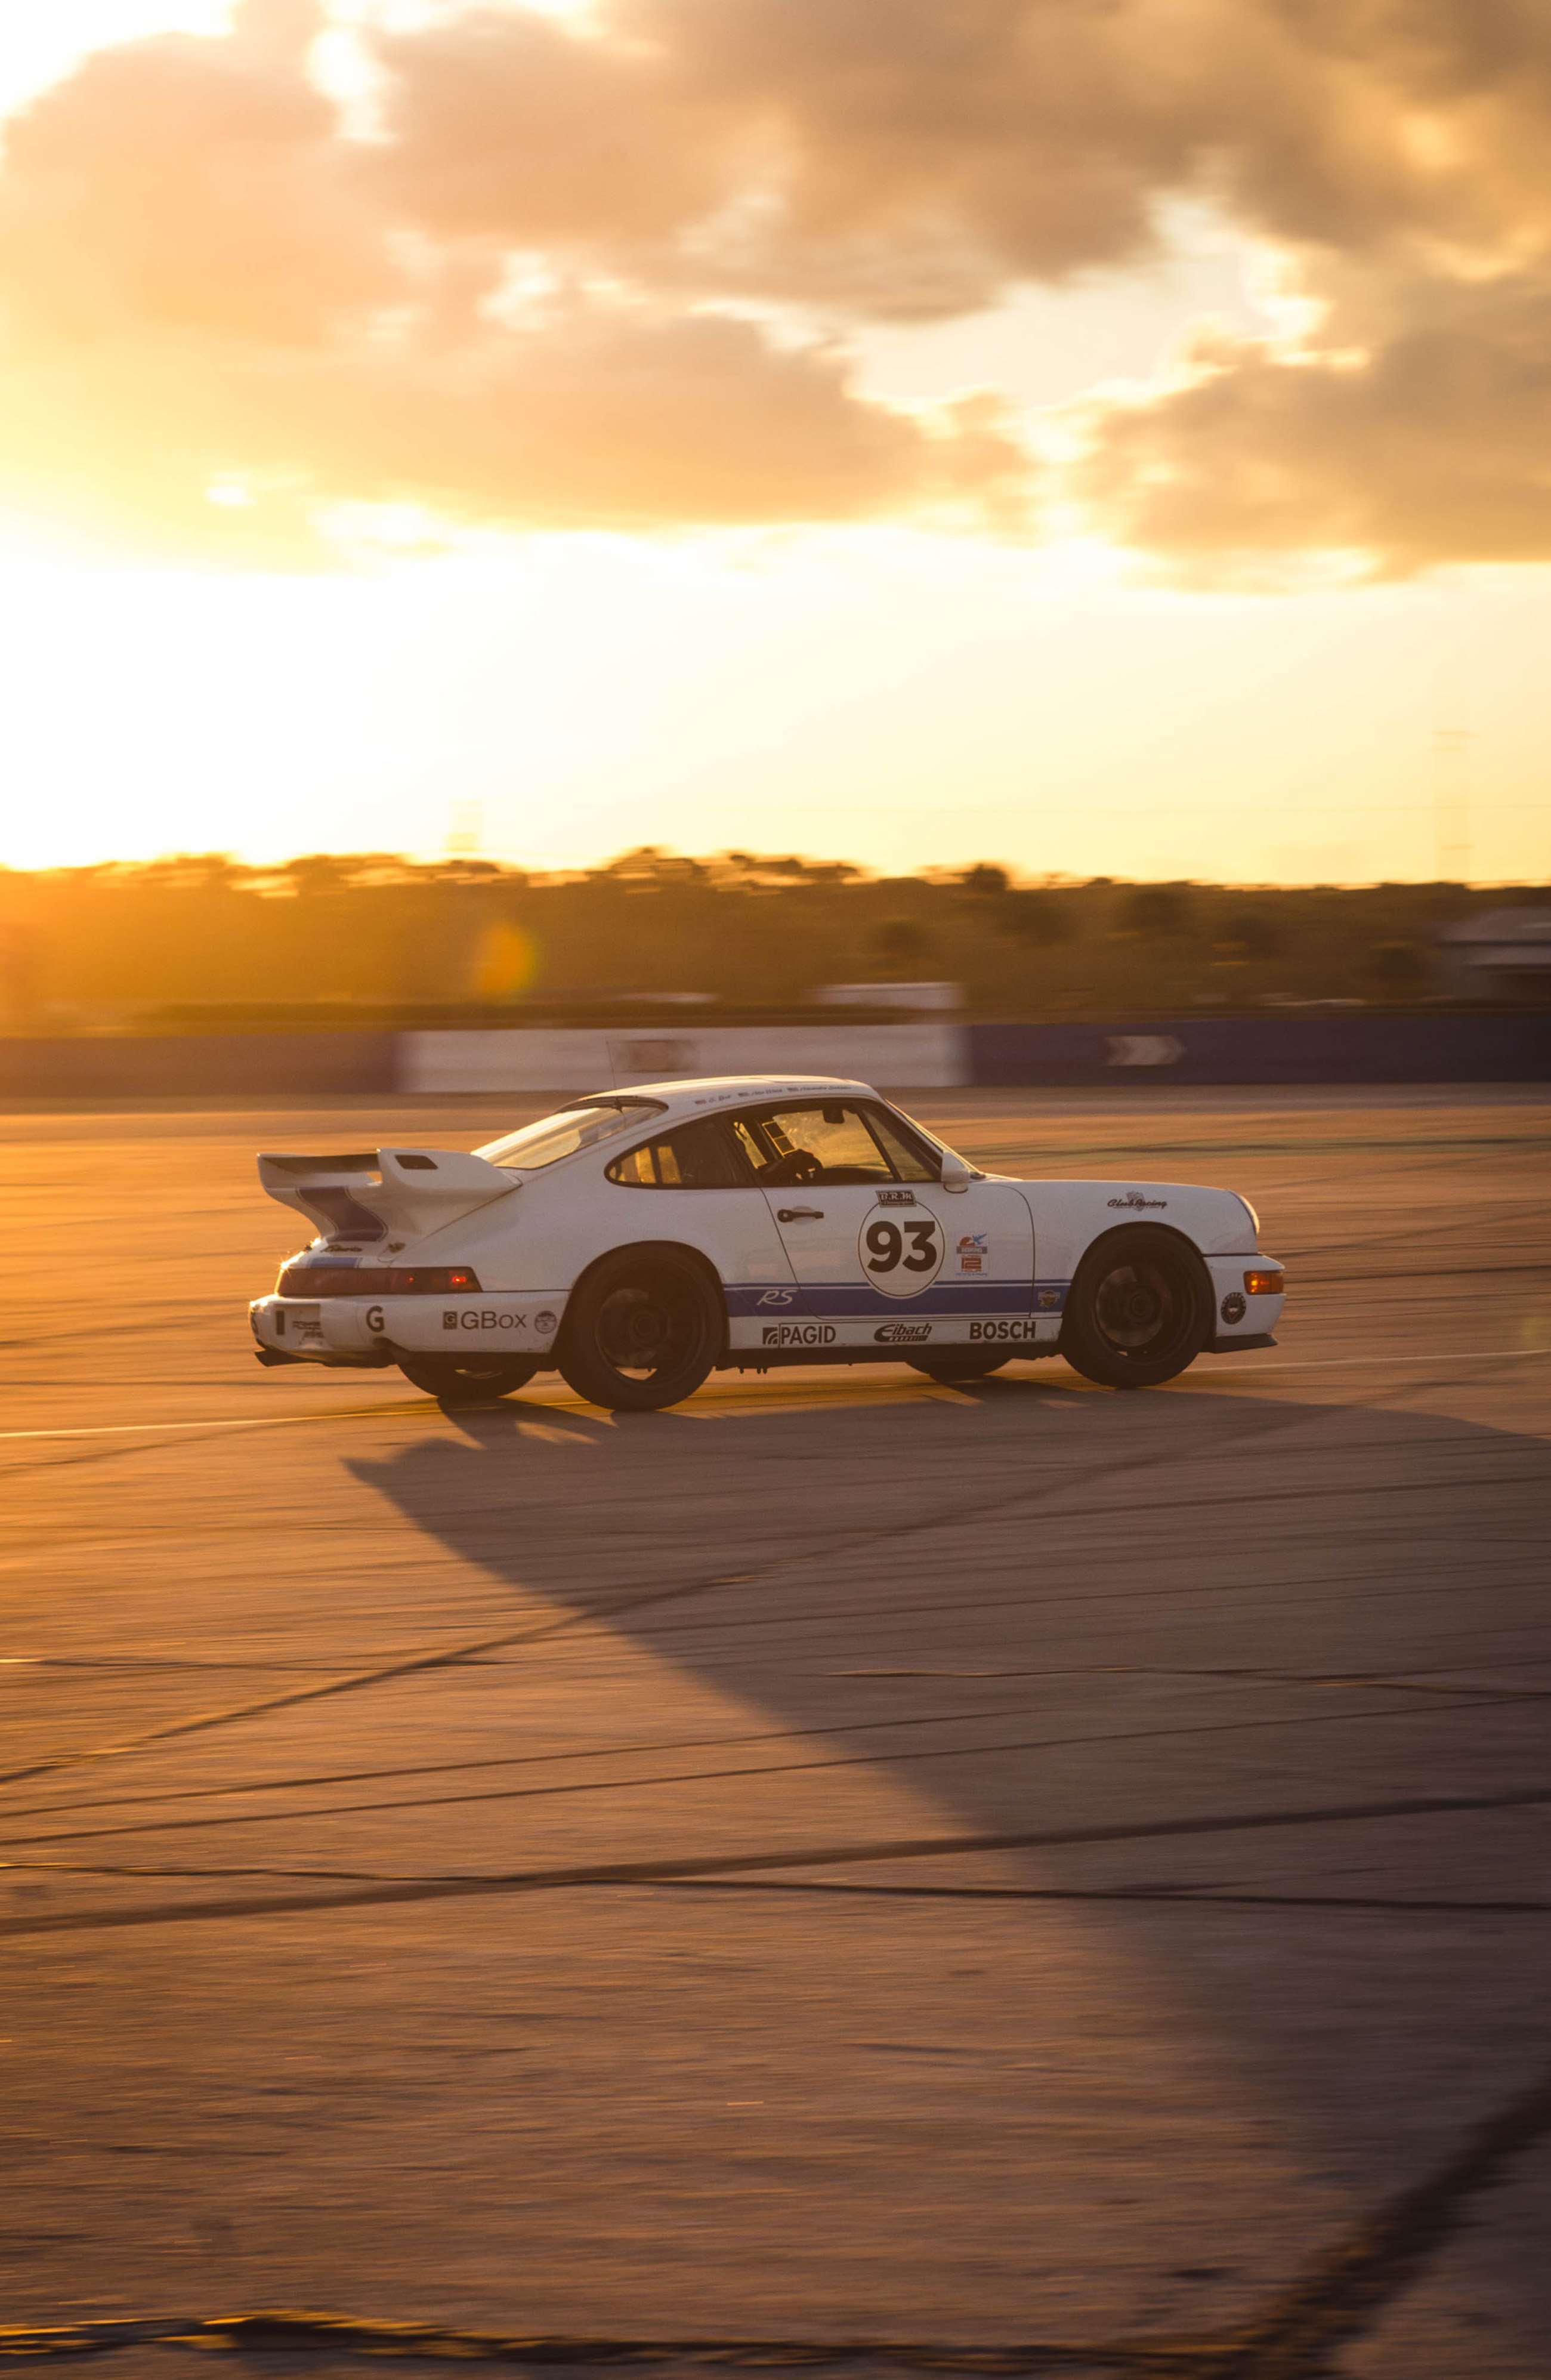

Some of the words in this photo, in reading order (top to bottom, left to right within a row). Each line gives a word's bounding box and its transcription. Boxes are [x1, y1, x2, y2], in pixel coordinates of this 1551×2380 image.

[866, 1221, 937, 1273] 93
[756, 1289, 798, 1305] RS
[366, 1305, 385, 1332] G
[461, 1311, 527, 1330] GBox
[781, 1326, 836, 1344] PAGID
[874, 1323, 932, 1342] Eibach
[969, 1321, 1036, 1339] BOSCH
